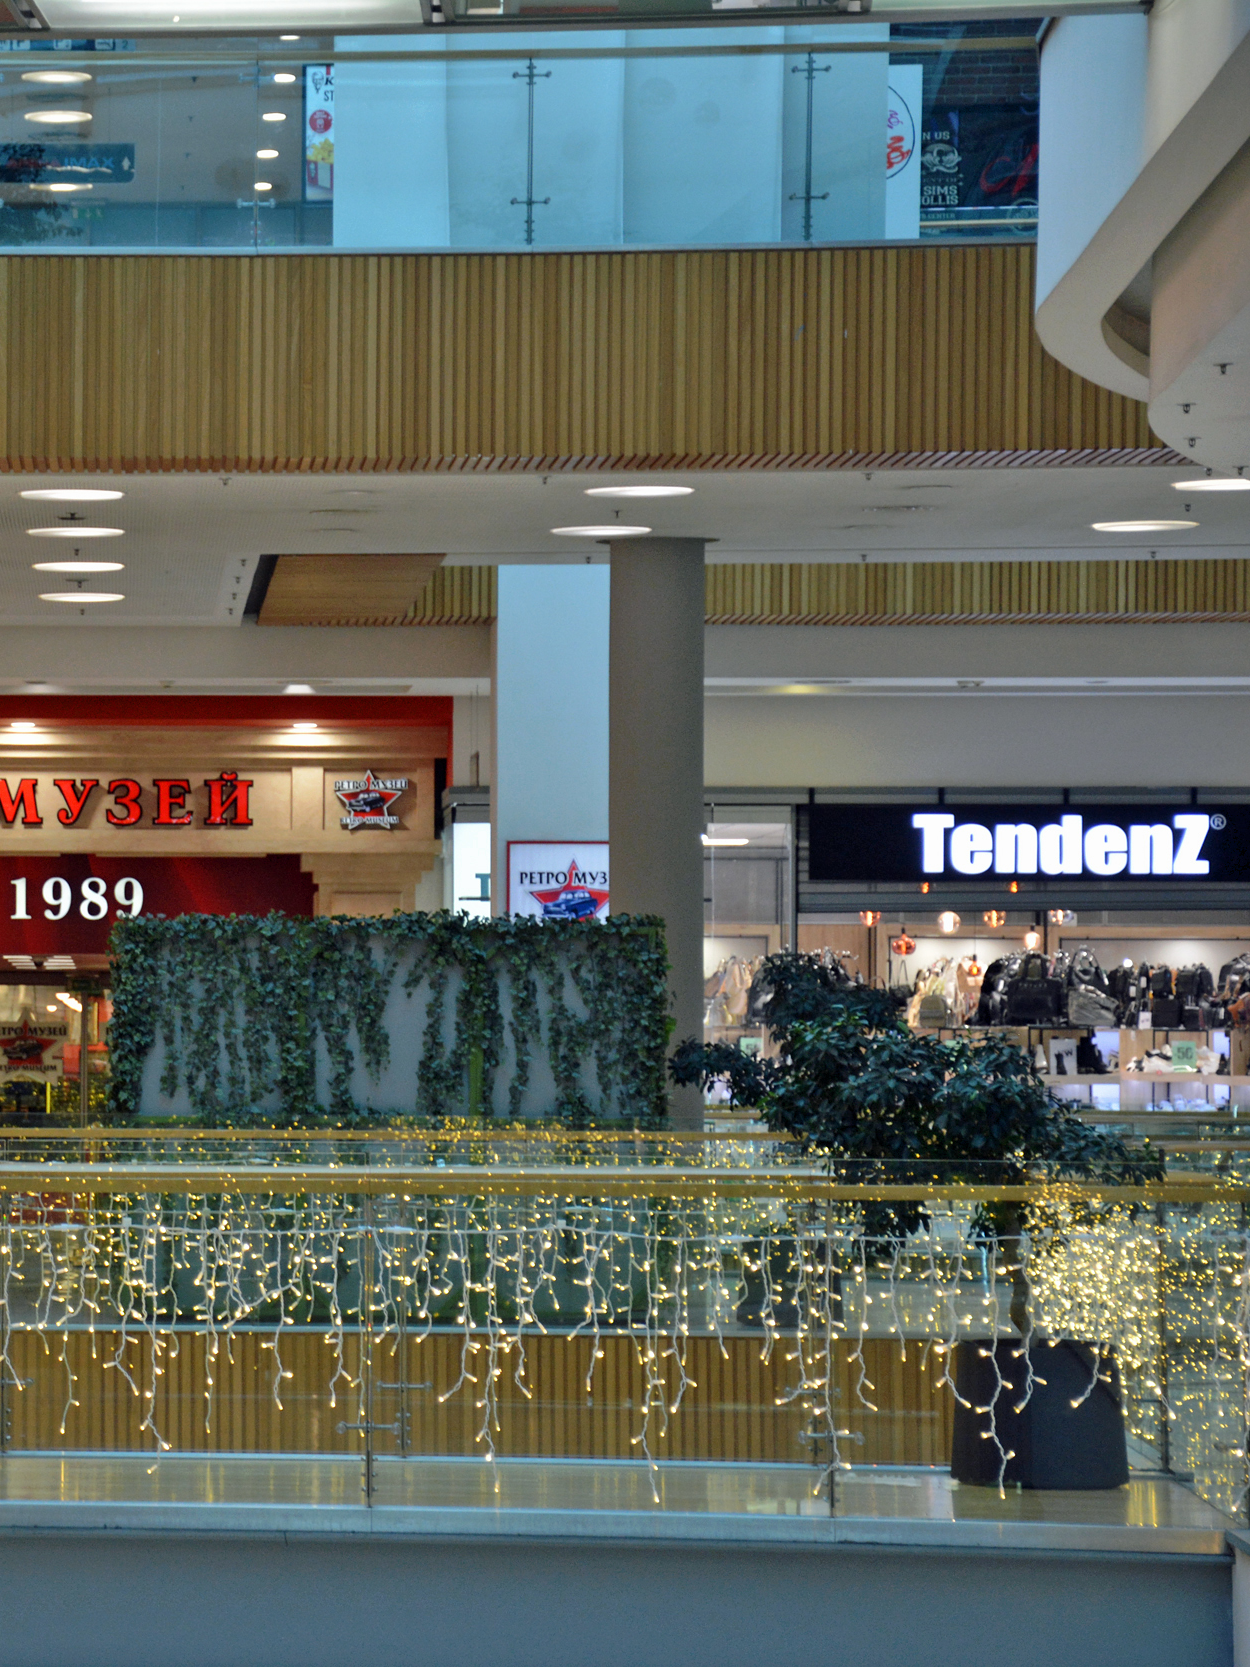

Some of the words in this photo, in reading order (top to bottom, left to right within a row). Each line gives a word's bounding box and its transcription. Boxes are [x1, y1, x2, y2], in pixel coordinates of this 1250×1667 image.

[923, 185, 958, 196] SIMS
[519, 871, 568, 885] РЕТРО
[10, 876, 144, 921] 1989
[27, 1025, 67, 1036] МУЗЕЙ
